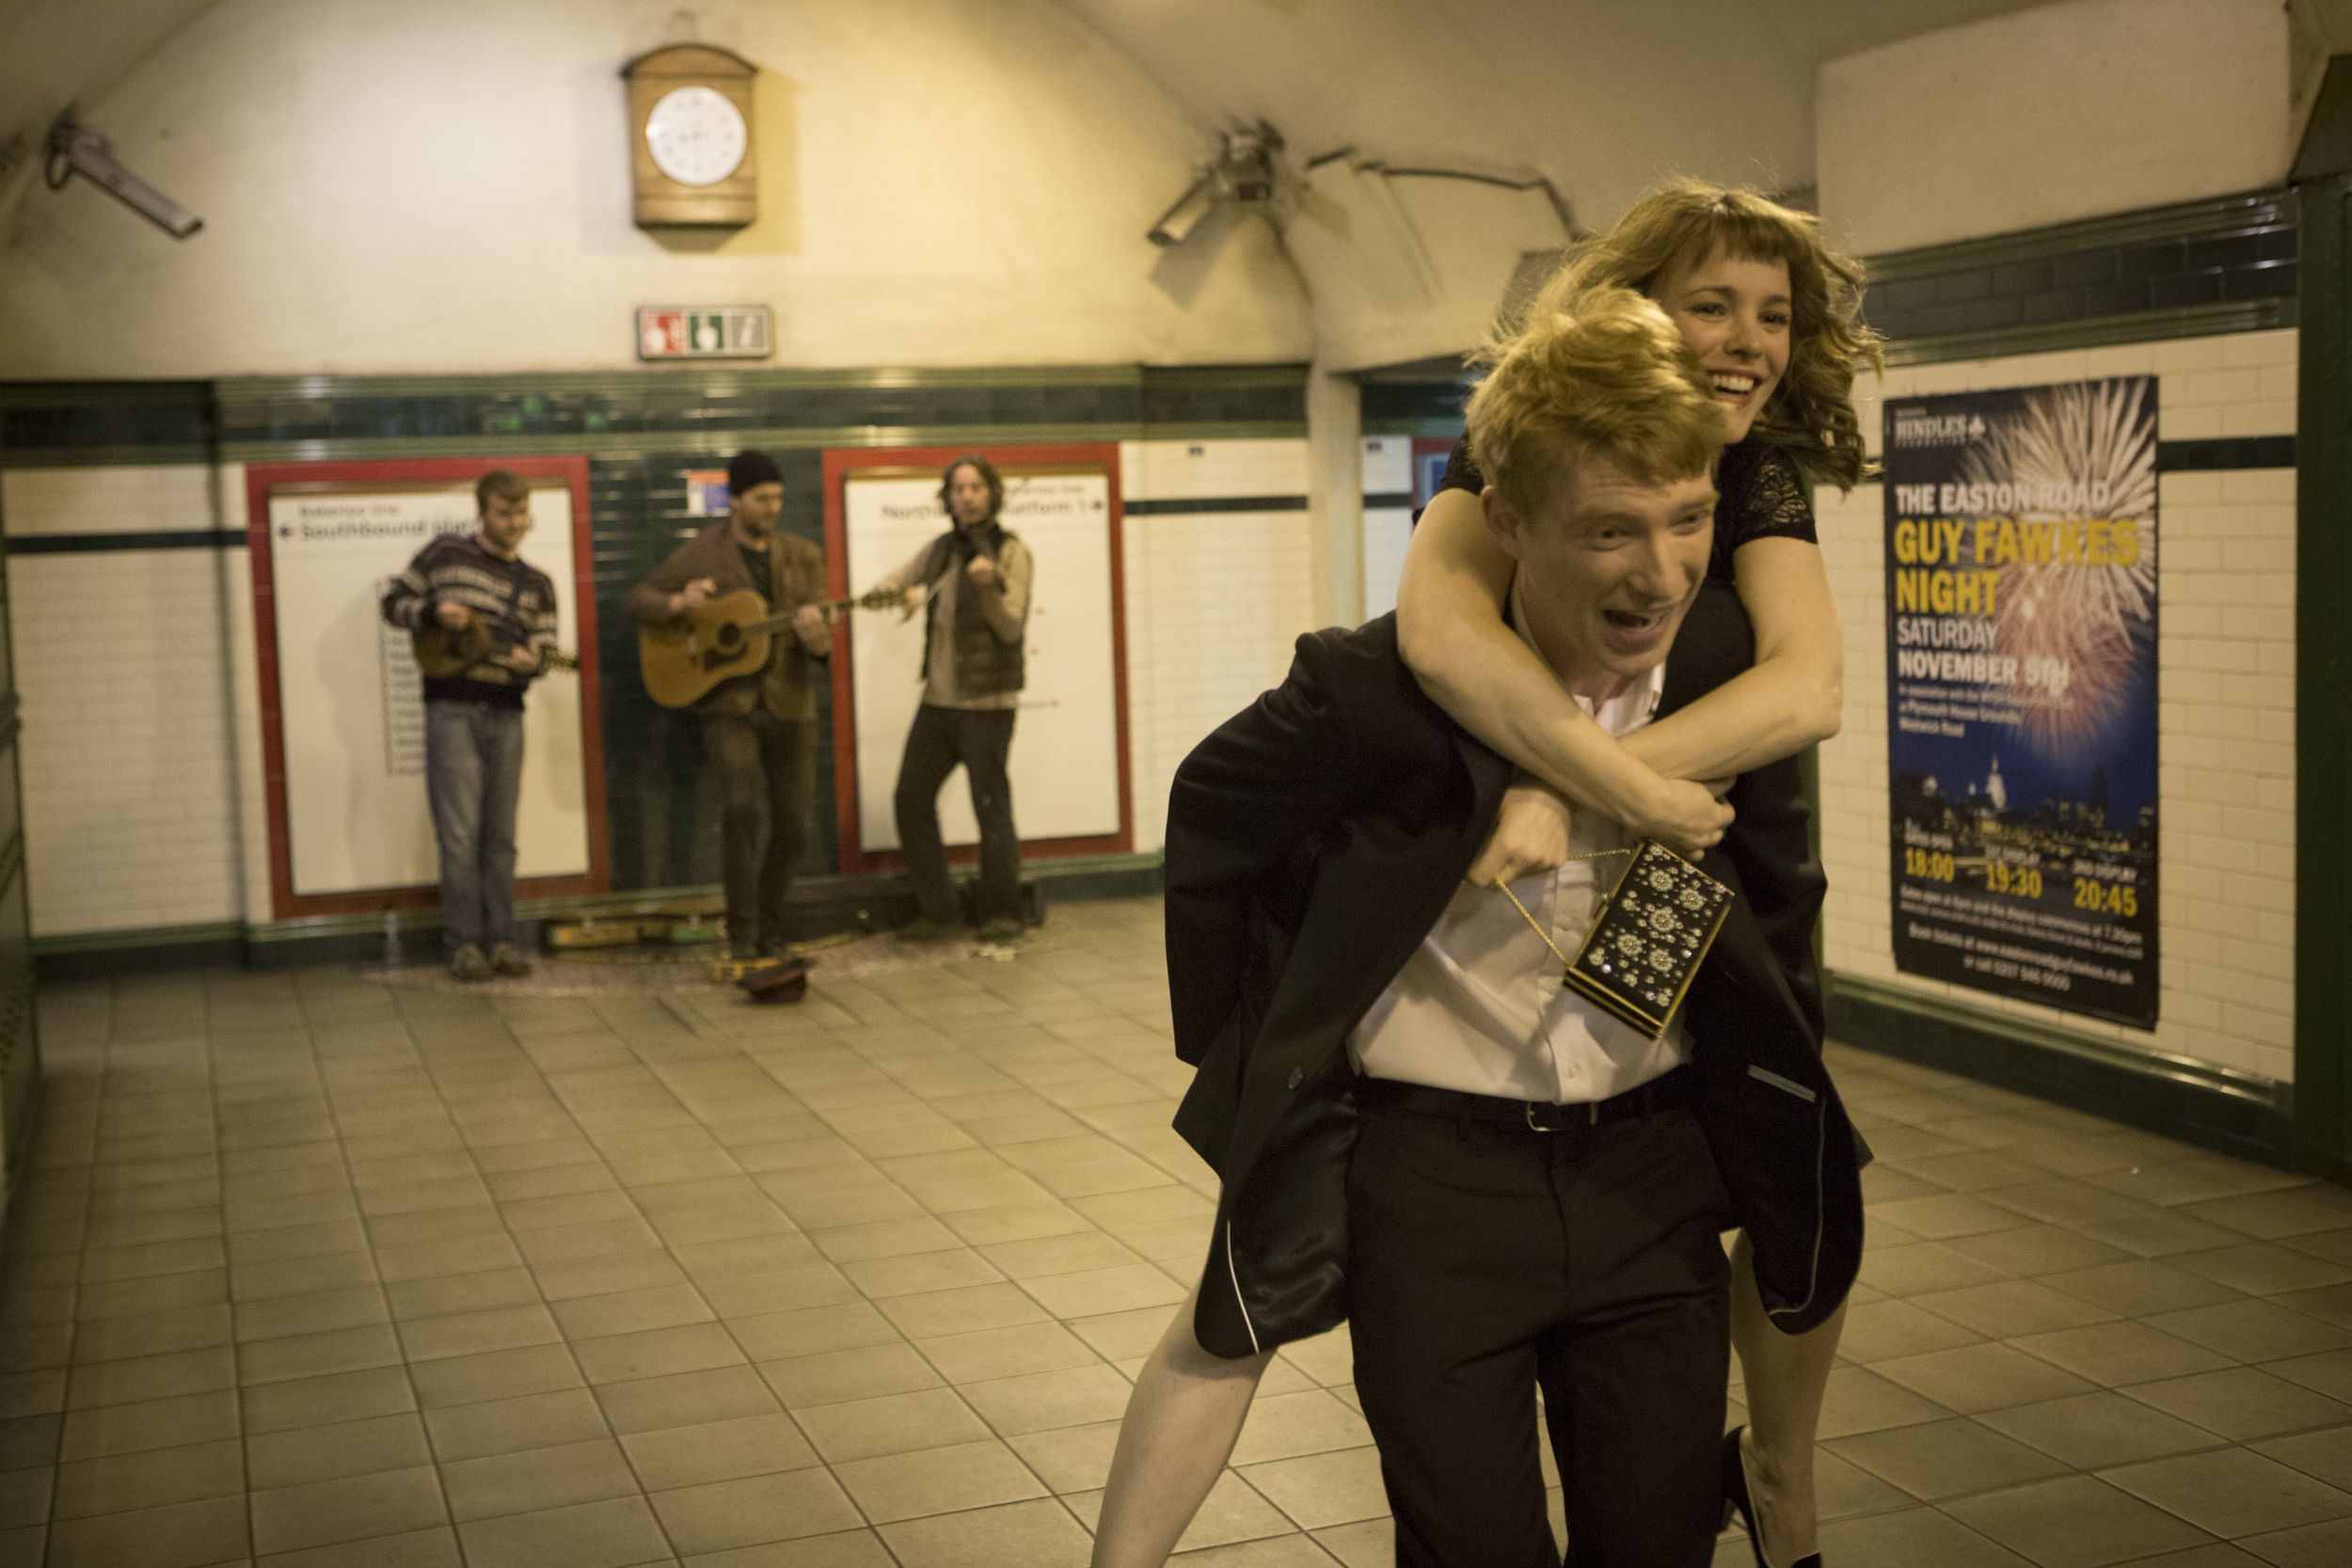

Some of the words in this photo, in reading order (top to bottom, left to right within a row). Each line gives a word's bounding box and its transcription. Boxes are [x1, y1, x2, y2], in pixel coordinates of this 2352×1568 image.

[1895, 483, 1936, 515] THE
[1940, 482, 2030, 515] EASTON
[2038, 480, 2109, 513] ROAD
[301, 519, 424, 540] Southbound
[1894, 519, 1965, 564] GUY
[1977, 518, 2139, 564] FAWKES
[1896, 567, 2000, 616] NIGHT
[1897, 616, 1998, 650] SATURDAY
[1898, 650, 2017, 685] NOVEMBER
[1905, 847, 1954, 883] 18:00
[1987, 858, 2042, 899] 19:30
[2074, 877, 2137, 917] 20:45
